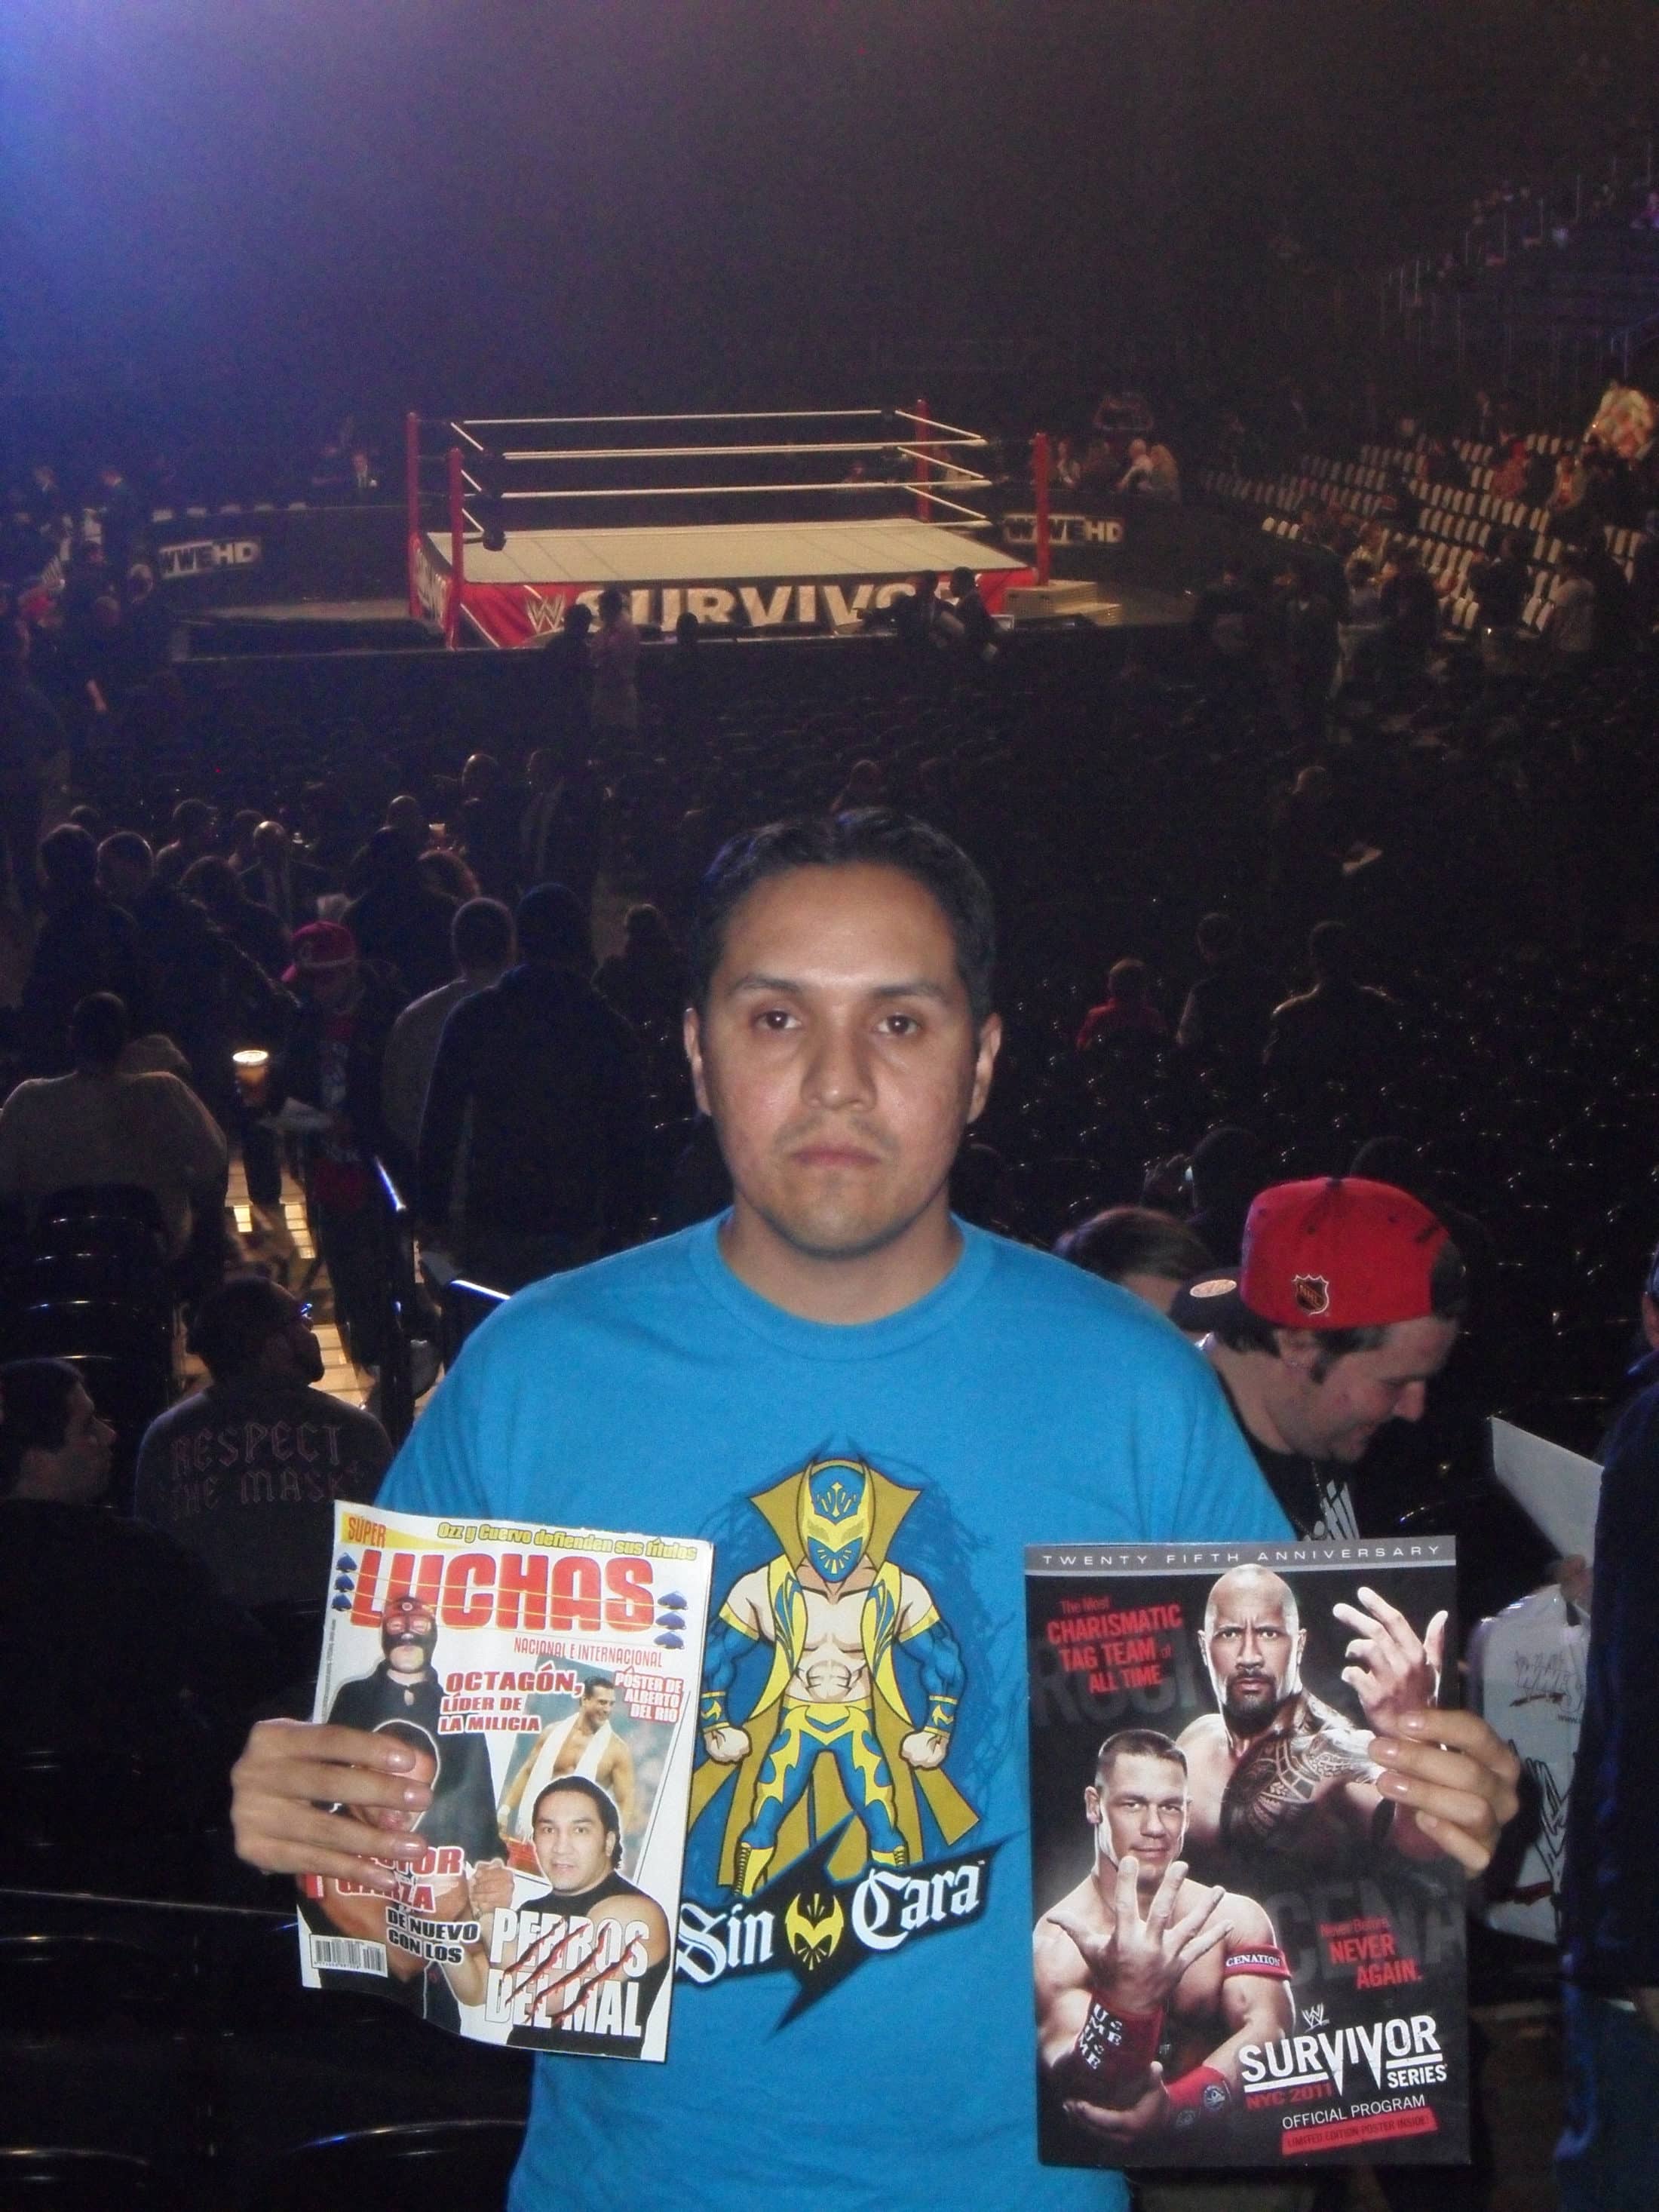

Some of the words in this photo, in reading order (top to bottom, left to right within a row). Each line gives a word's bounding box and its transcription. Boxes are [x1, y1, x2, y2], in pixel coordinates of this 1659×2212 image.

[575, 581, 960, 632] URVIV
[170, 1420, 341, 1472] RESPECT
[437, 1522, 465, 1539] Ozz
[465, 1526, 477, 1544] y
[478, 1523, 532, 1545] Cuervo
[533, 1529, 614, 1554] defienden
[615, 1539, 644, 1556] sus
[1043, 1555, 1148, 1566] TWENTY
[1166, 1553, 1240, 1564] FIFTH
[1257, 1545, 1440, 1561] ANNIVERSARY
[350, 1548, 655, 1632] LUCHAS
[1047, 1603, 1183, 1645] CHARISMATIC
[514, 1637, 566, 1658] NACIONAL
[570, 1643, 576, 1657] E
[578, 1645, 663, 1668] INTERNACIONAL
[1059, 1646, 1099, 1672] TAG
[1100, 1637, 1157, 1666] TEAM
[664, 1678, 683, 1693] DE
[1088, 1671, 1119, 1695] ALL
[1121, 1664, 1163, 1688] TIME
[498, 1697, 522, 1712] DE
[624, 1689, 681, 1708] ALBERTO
[630, 1704, 653, 1720] DEL
[440, 1717, 463, 1732] LA
[467, 1716, 541, 1732] MILICIA
[387, 1907, 409, 1928] DE
[409, 1916, 480, 1942] NUEVO
[676, 1902, 775, 1984] Sin
[852, 1864, 981, 1951] Cara
[388, 1928, 422, 1955] CON
[425, 1945, 464, 1964] LOS
[489, 1907, 650, 1978] PERROS
[1329, 1933, 1396, 1965] NEVER
[1357, 1958, 1423, 1990] AGAIN.
[485, 1969, 553, 2029] DEL
[561, 1977, 642, 2038] MAL
[1237, 2014, 1443, 2097] SURVIVOR
[1386, 2063, 1447, 2089] SERIES
[1245, 2092, 1286, 2110] NYC
[1291, 2083, 1334, 2102] 2011
[1282, 2107, 1348, 2130] OFFICIAL
[1351, 2094, 1425, 2118] PROGRAM
[1286, 2134, 1323, 2148] LIMITED
[1326, 2128, 1359, 2143] EDITION
[1361, 2121, 1396, 2135] POSTER
